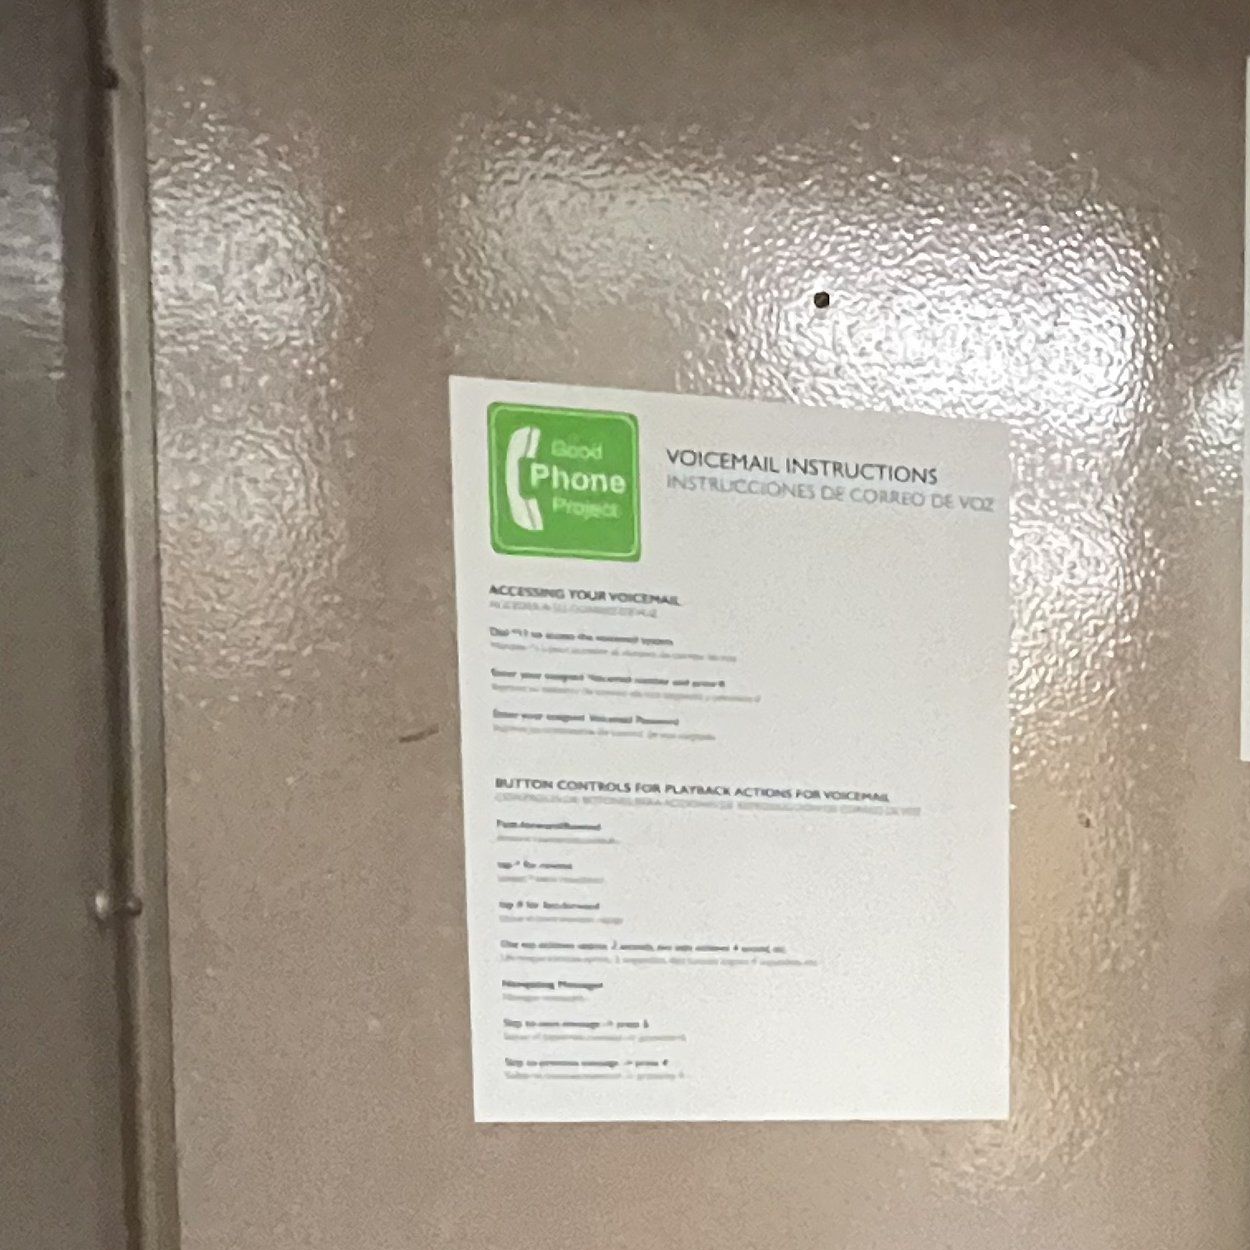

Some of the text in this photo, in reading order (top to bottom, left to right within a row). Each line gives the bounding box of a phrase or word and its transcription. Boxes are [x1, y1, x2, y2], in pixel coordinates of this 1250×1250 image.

[530, 461, 627, 494] Phone
[666, 449, 938, 485] VOICEMAIL INSTRUCTIONS
[666, 474, 994, 513] INSTRUCCIONES DE CORREO DE VOZ
[489, 584, 565, 600] ACCESSING
[568, 588, 605, 601] YOUR
[495, 778, 553, 789] BUTTON
[557, 780, 631, 793] CONTROLS
[635, 783, 661, 794] FOR
[664, 784, 730, 796] PLAYBACK
